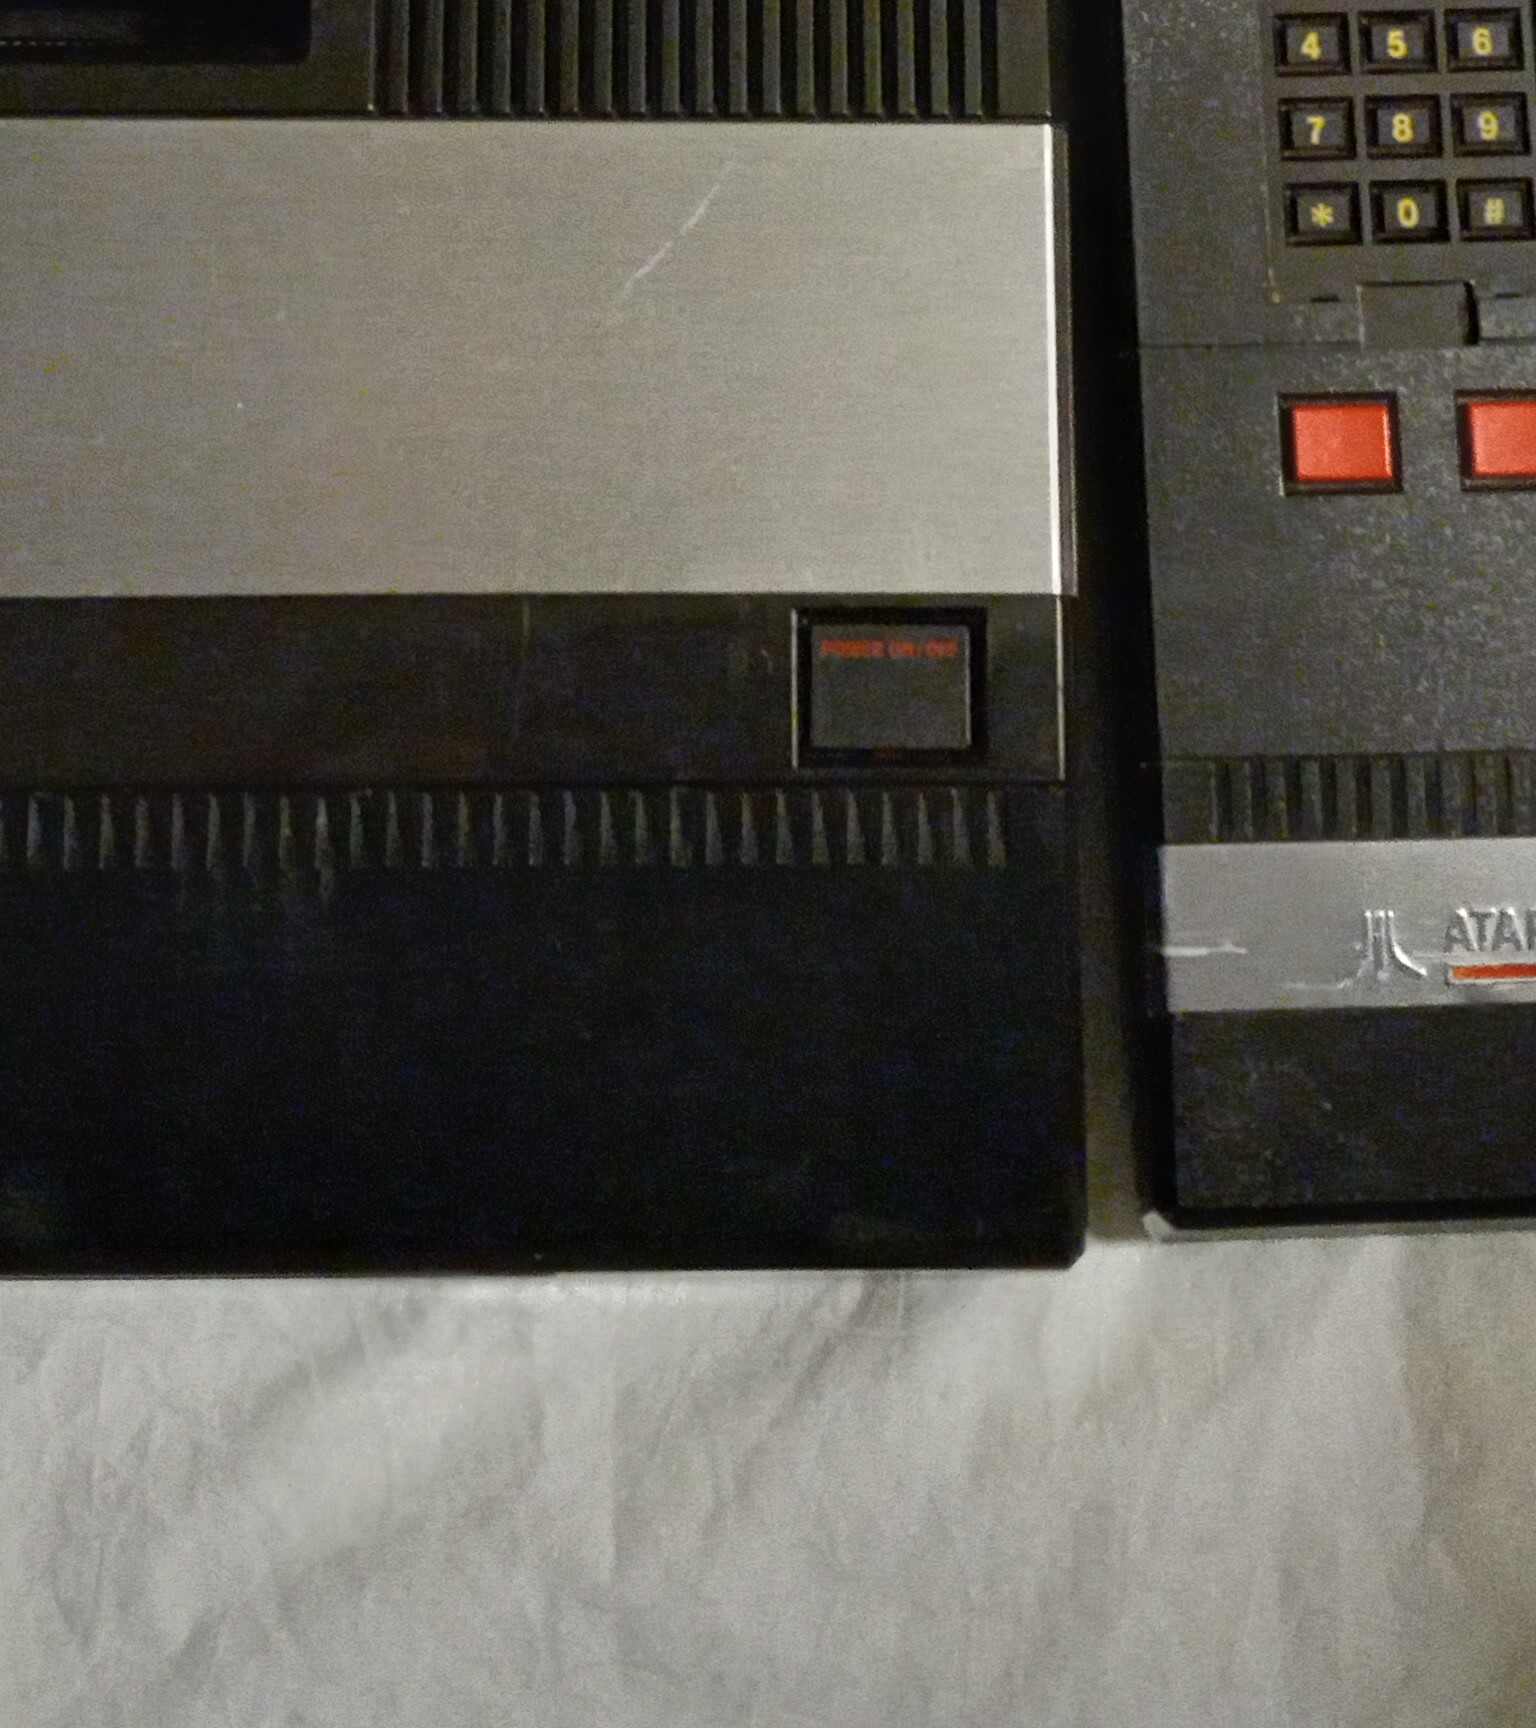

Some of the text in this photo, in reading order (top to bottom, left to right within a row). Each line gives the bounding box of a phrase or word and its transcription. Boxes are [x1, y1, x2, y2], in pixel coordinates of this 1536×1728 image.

[1302, 25, 1494, 60] 4 5 6
[1308, 110, 1500, 143] 7 8 9
[1397, 195, 1420, 228] 0
